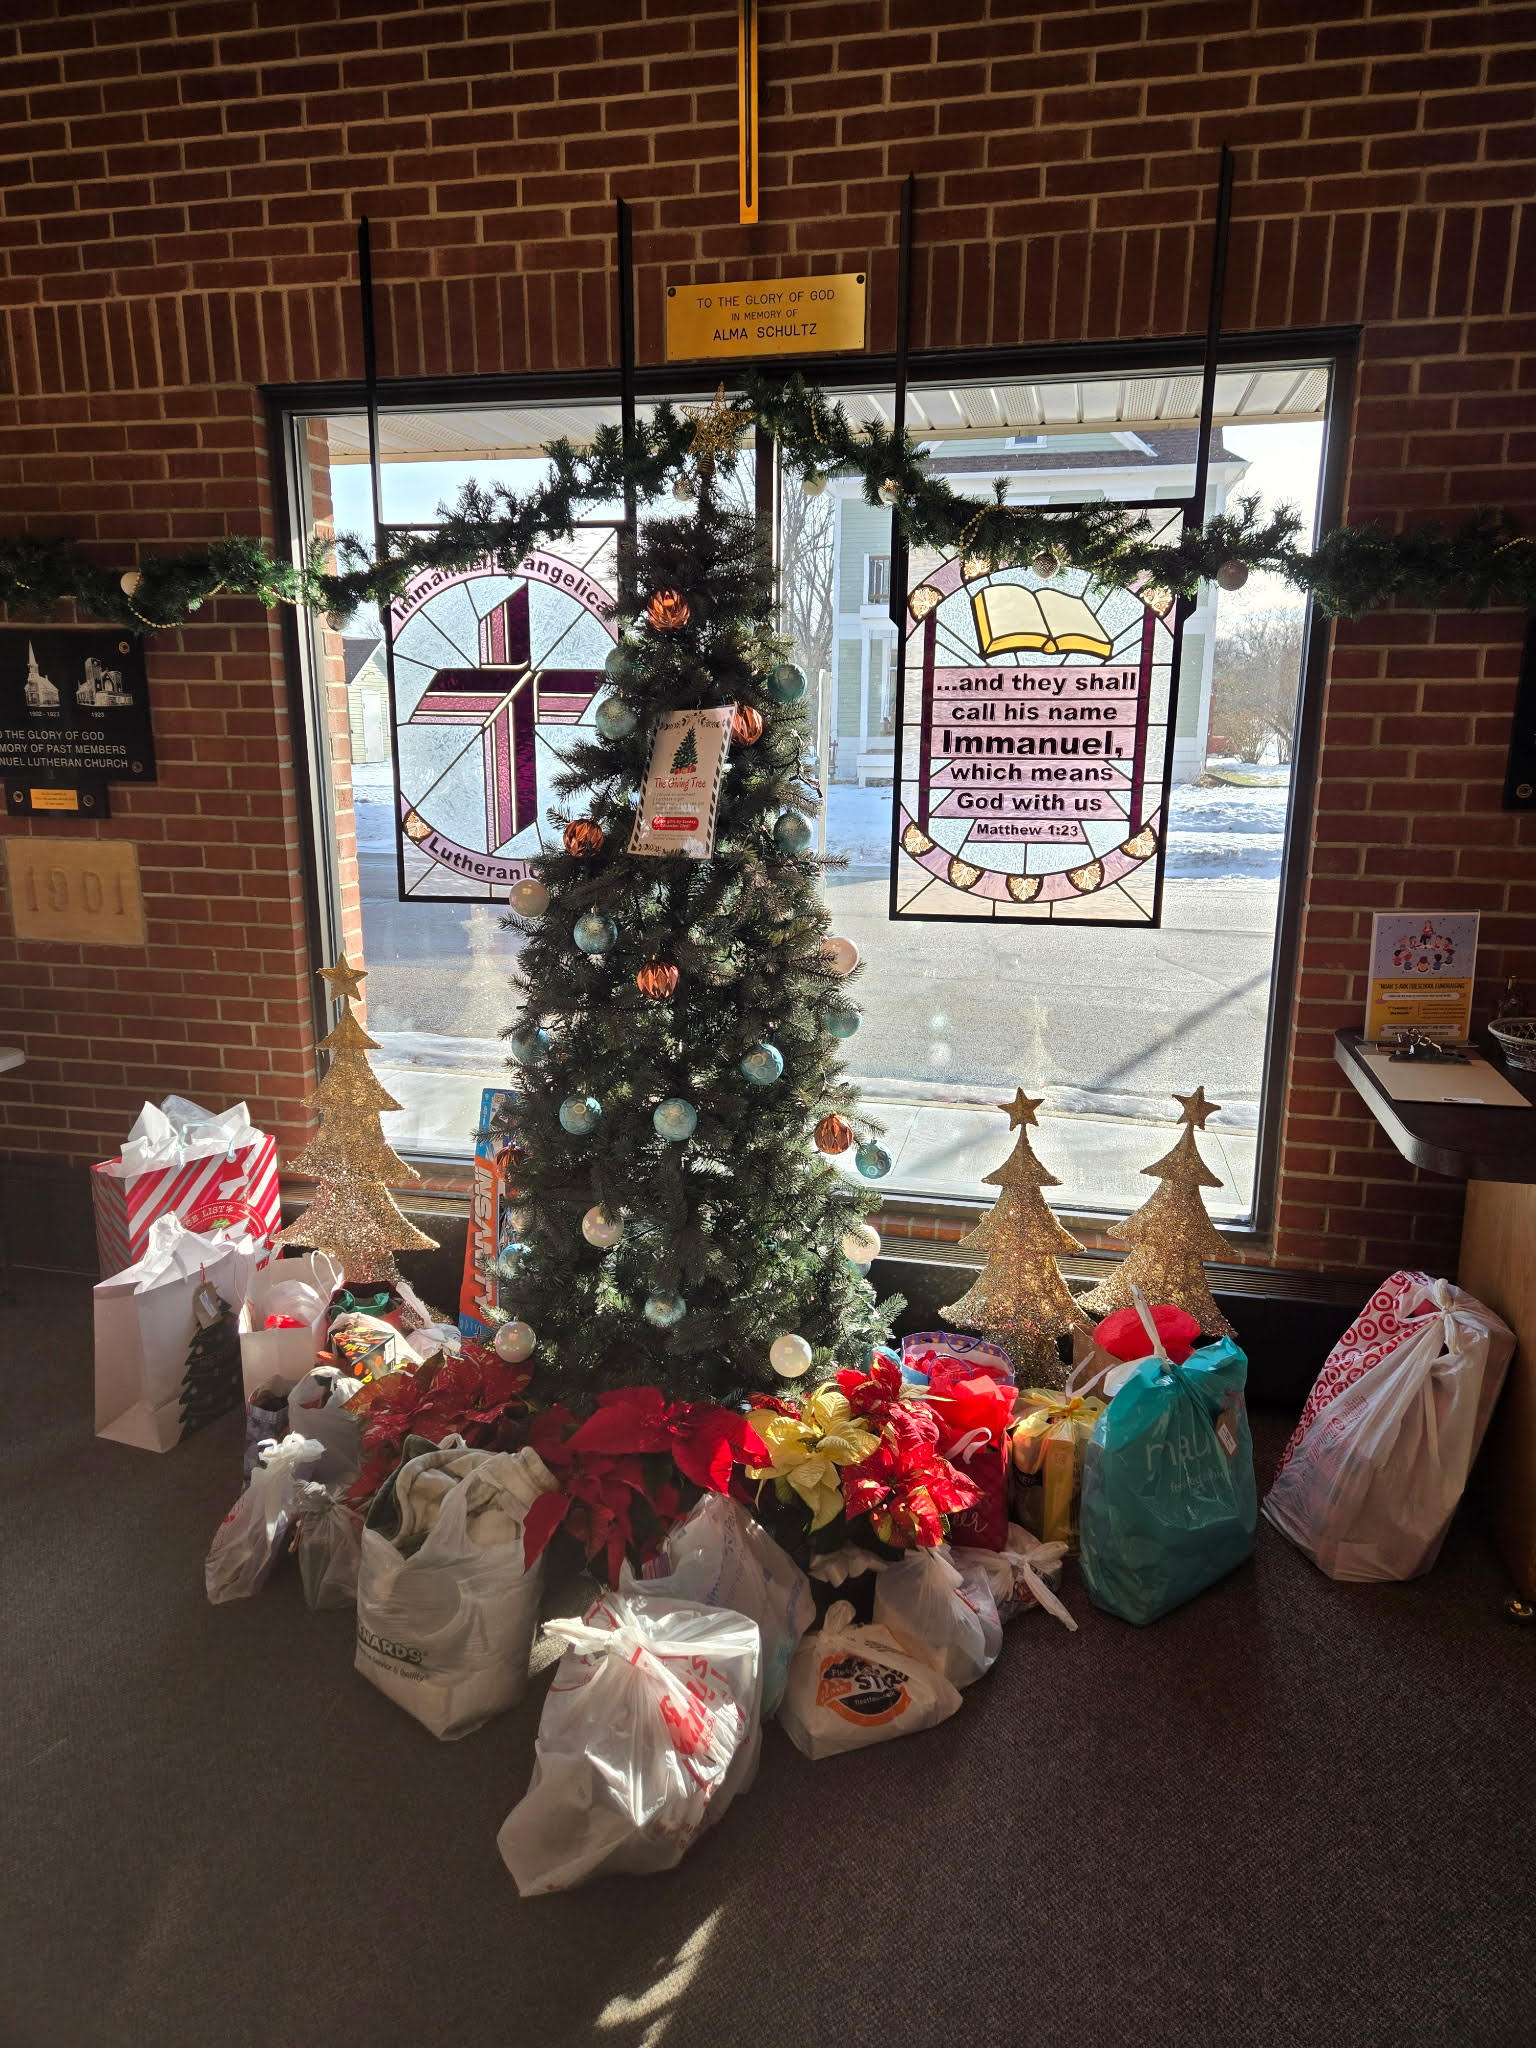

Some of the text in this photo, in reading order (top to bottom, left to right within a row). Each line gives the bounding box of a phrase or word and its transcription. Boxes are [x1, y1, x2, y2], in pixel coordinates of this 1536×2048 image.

[696, 289, 835, 309] TO THE GLORY OF GOD
[731, 309, 799, 321] IN MEMORY OF
[713, 323, 817, 341] ALMA SCHULTZ
[1012, 673, 1067, 696] they
[1075, 672, 1136, 691] shall
[951, 703, 1118, 721] call his name
[5, 730, 25, 739] THE
[28, 730, 62, 740] GLORY
[65, 731, 79, 740] OF
[81, 731, 105, 741] GOD
[943, 729, 1123, 758] Immanuel,
[0, 744, 127, 755] MORY OF PAST MEMBERS
[0, 757, 128, 768] NUEL LUTHERAN CHURCH
[950, 763, 1113, 782] which means
[655, 776, 706, 791] The Giving Tree
[957, 792, 1102, 811] God with us
[977, 823, 1078, 837] Matthew 1:23
[428, 835, 521, 880] Lutheran
[25, 865, 125, 915] 1901
[202, 1205, 225, 1217] LIST
[473, 1165, 493, 1308] INSANITY
[360, 1627, 423, 1666] NARDS
